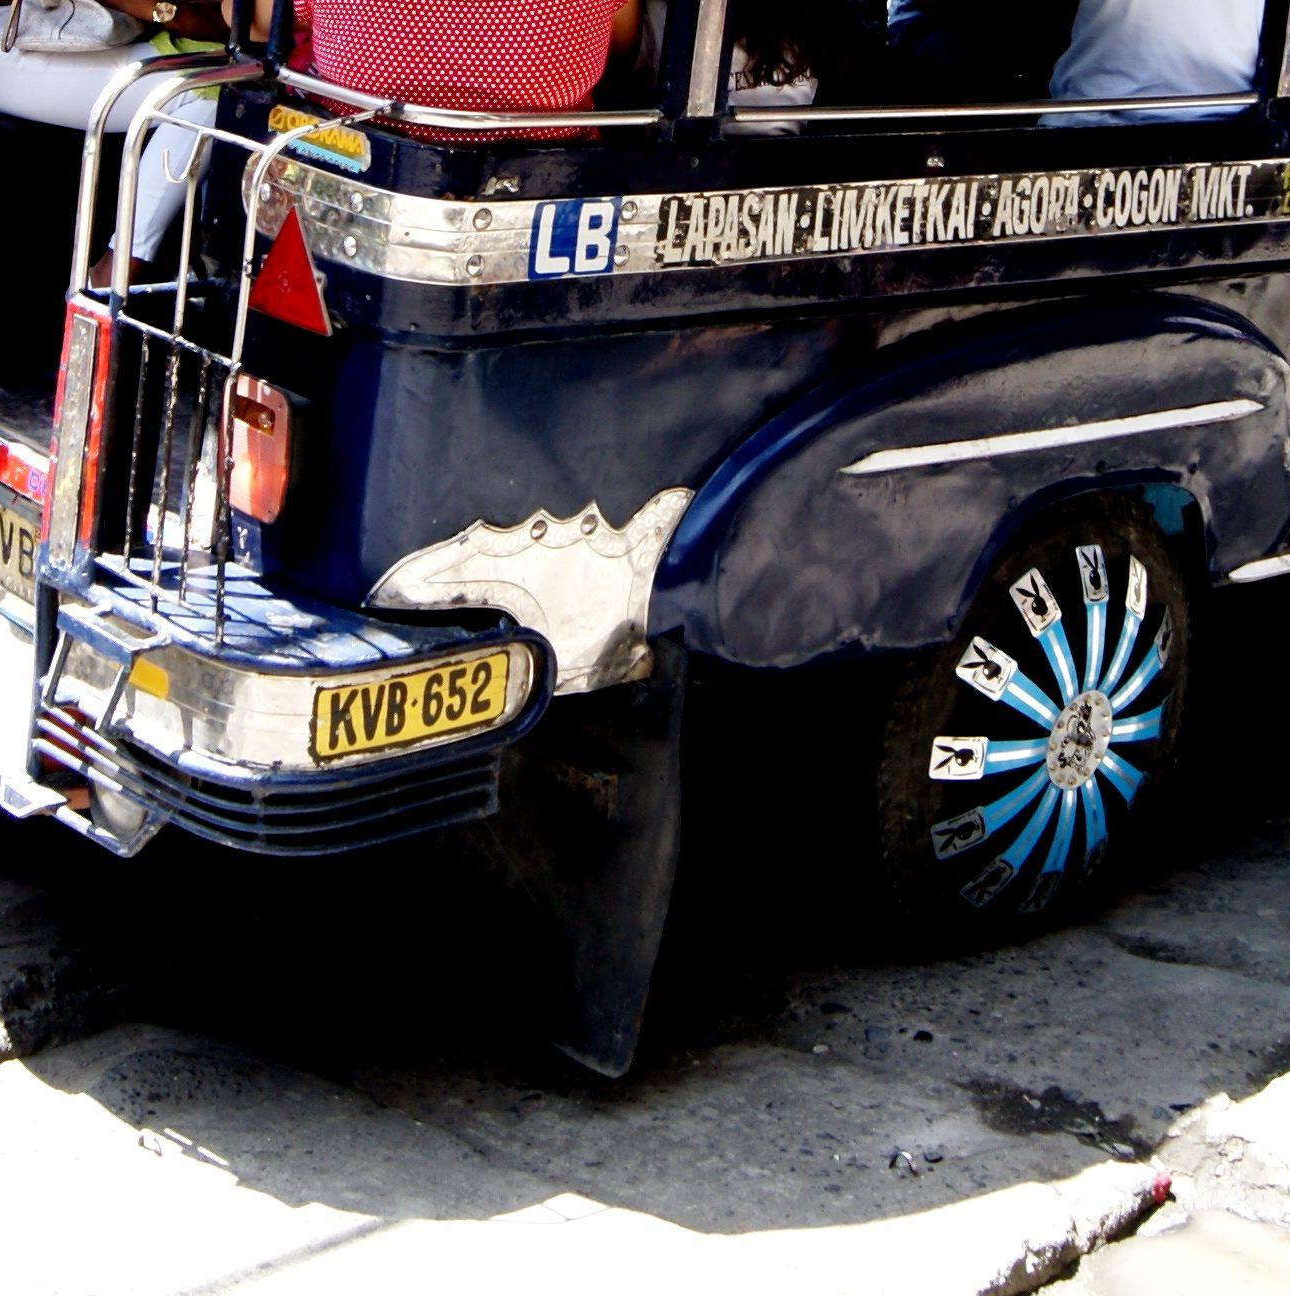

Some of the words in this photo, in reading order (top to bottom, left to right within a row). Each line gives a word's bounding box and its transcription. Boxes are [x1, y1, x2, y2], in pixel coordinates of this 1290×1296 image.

[534, 202, 613, 275] LB
[662, 192, 797, 264] LAPASAN
[993, 175, 1080, 237] AGORA
[1096, 169, 1181, 228] COGON
[1191, 166, 1254, 221] MKT.
